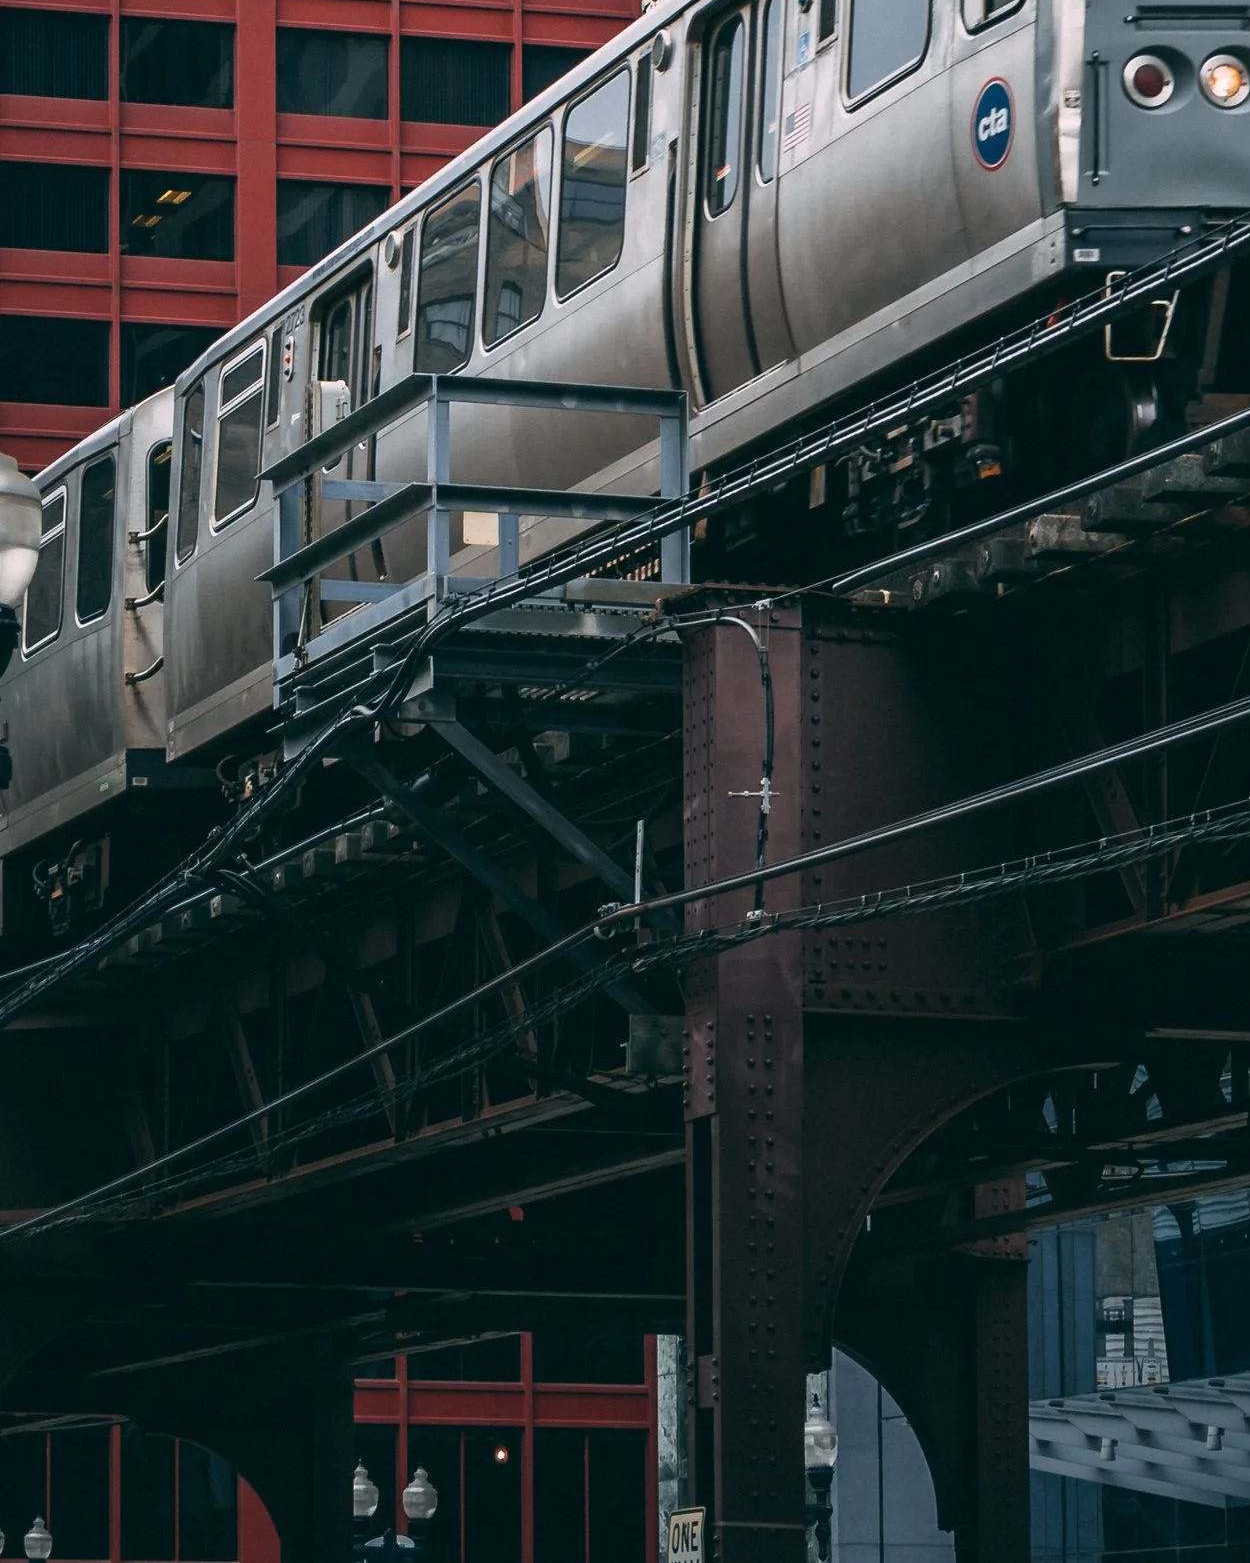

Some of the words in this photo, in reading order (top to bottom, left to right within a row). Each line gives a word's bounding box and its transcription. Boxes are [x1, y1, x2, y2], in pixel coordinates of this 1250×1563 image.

[978, 107, 1008, 141] cta
[285, 304, 305, 335] 2723
[672, 1521, 699, 1554] ONE
